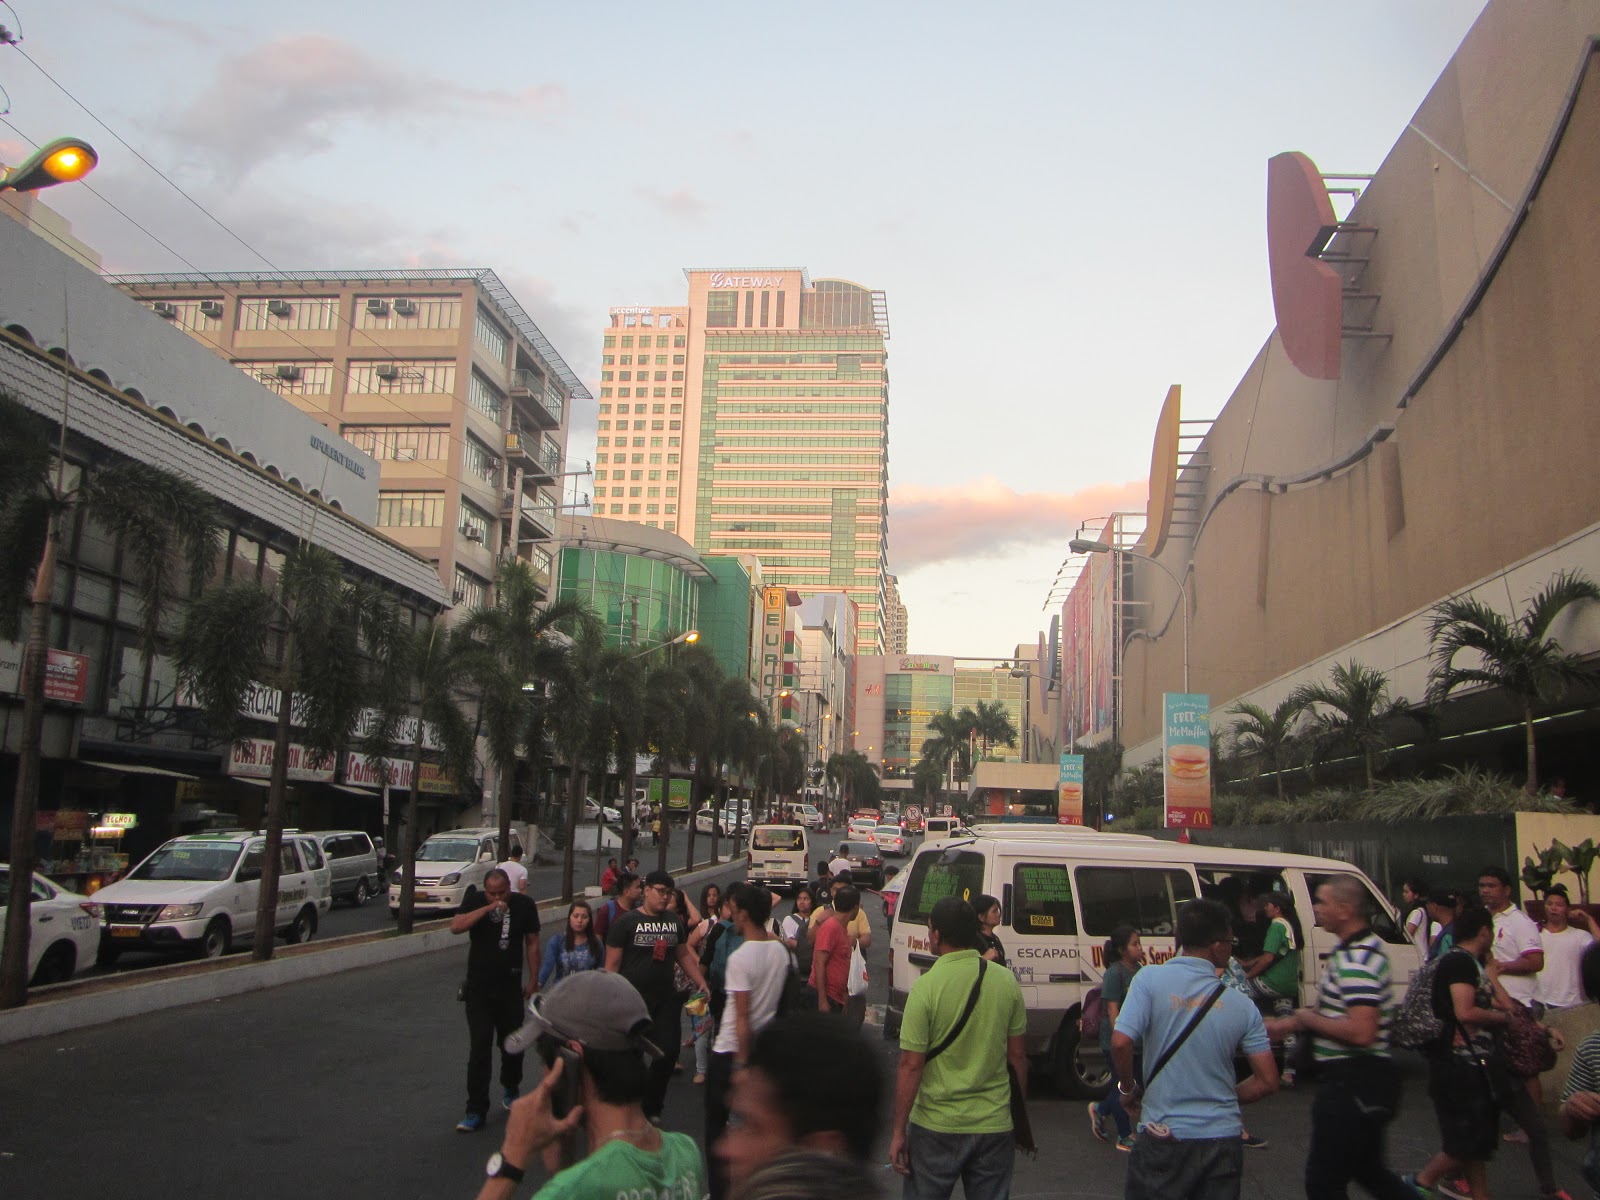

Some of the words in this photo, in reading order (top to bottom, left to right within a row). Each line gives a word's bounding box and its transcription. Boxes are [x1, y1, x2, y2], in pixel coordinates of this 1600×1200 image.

[710, 273, 783, 288] GATEWAY
[612, 304, 651, 314] accenture
[241, 686, 280, 717] ERCIAL
[1173, 712, 1195, 723] FREE
[1169, 725, 1206, 739] McMuffin
[260, 745, 300, 768] FAON
[302, 749, 334, 771] CETER
[635, 922, 677, 933] ARMANI
[636, 934, 678, 943] EXCHNGE
[1017, 948, 1079, 958] ESCAPAD
[1149, 946, 1177, 965] Servi
